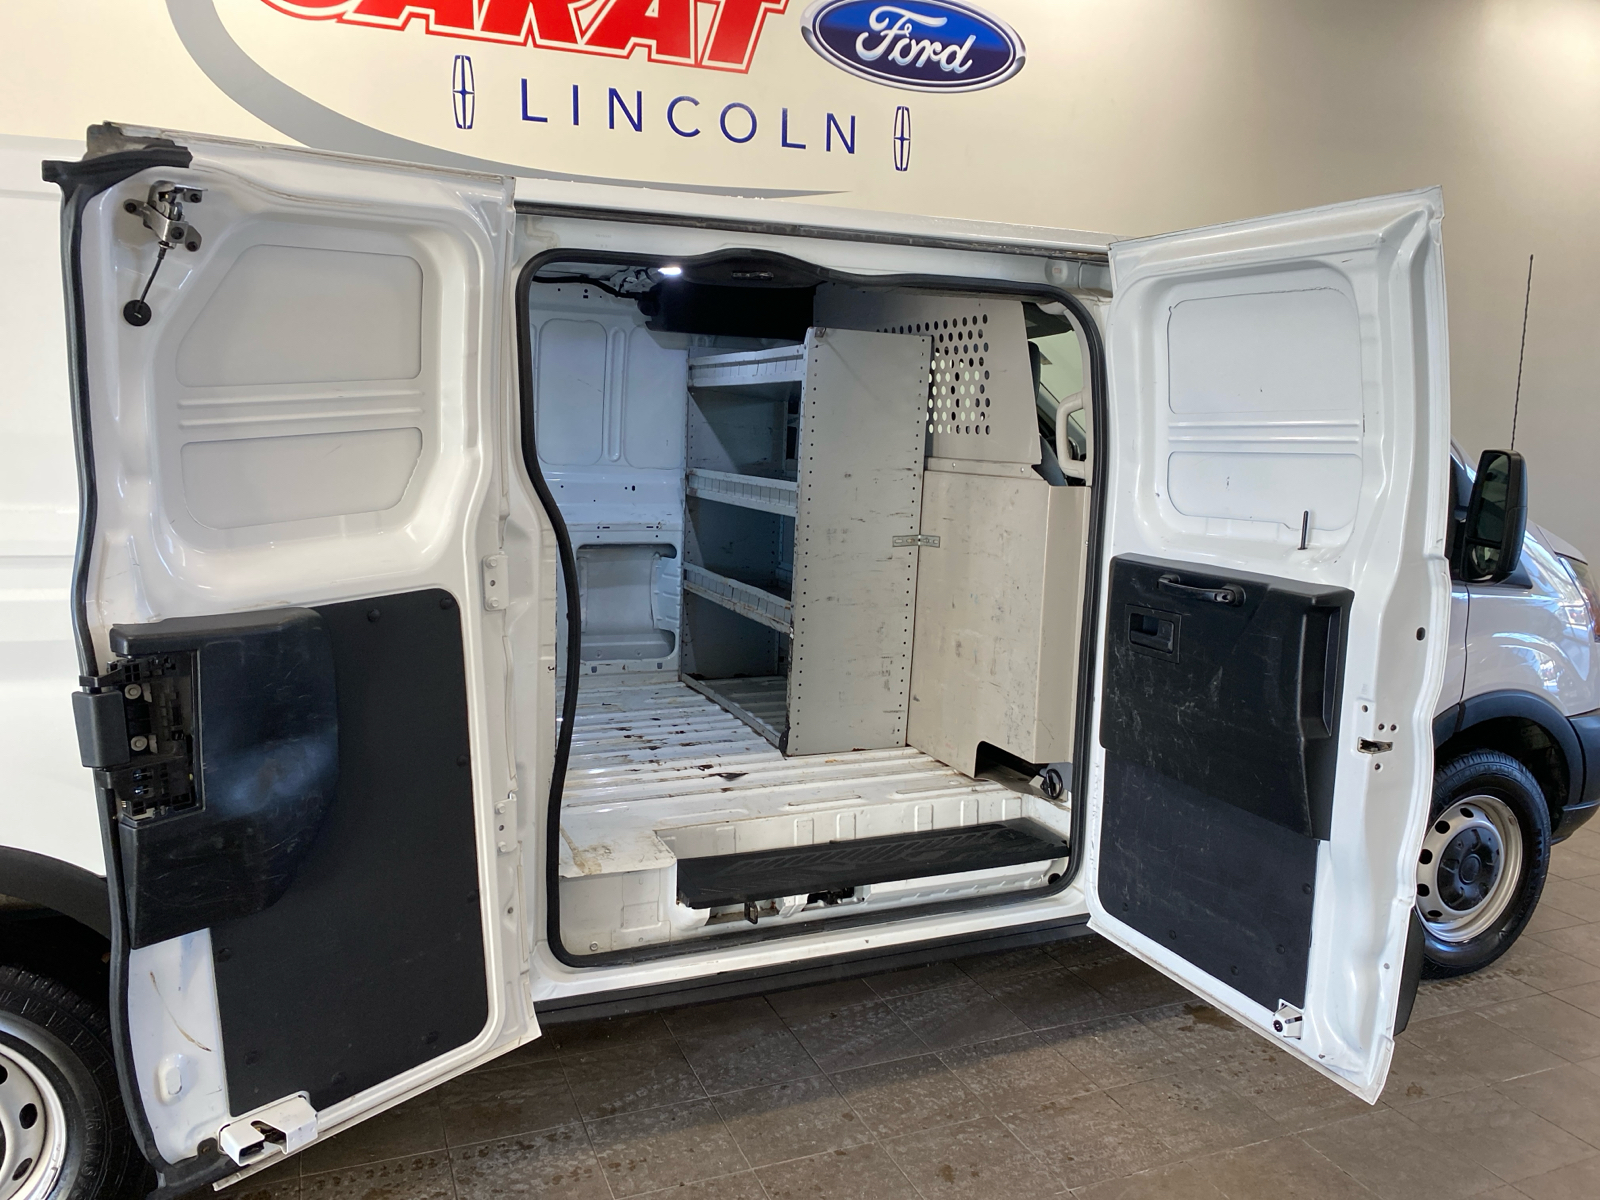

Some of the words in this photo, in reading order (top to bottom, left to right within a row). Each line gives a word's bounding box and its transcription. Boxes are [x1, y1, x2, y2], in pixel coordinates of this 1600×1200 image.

[260, 0, 789, 74] RAT
[855, 5, 977, 74] Ford
[520, 77, 856, 155] LINCOLN
